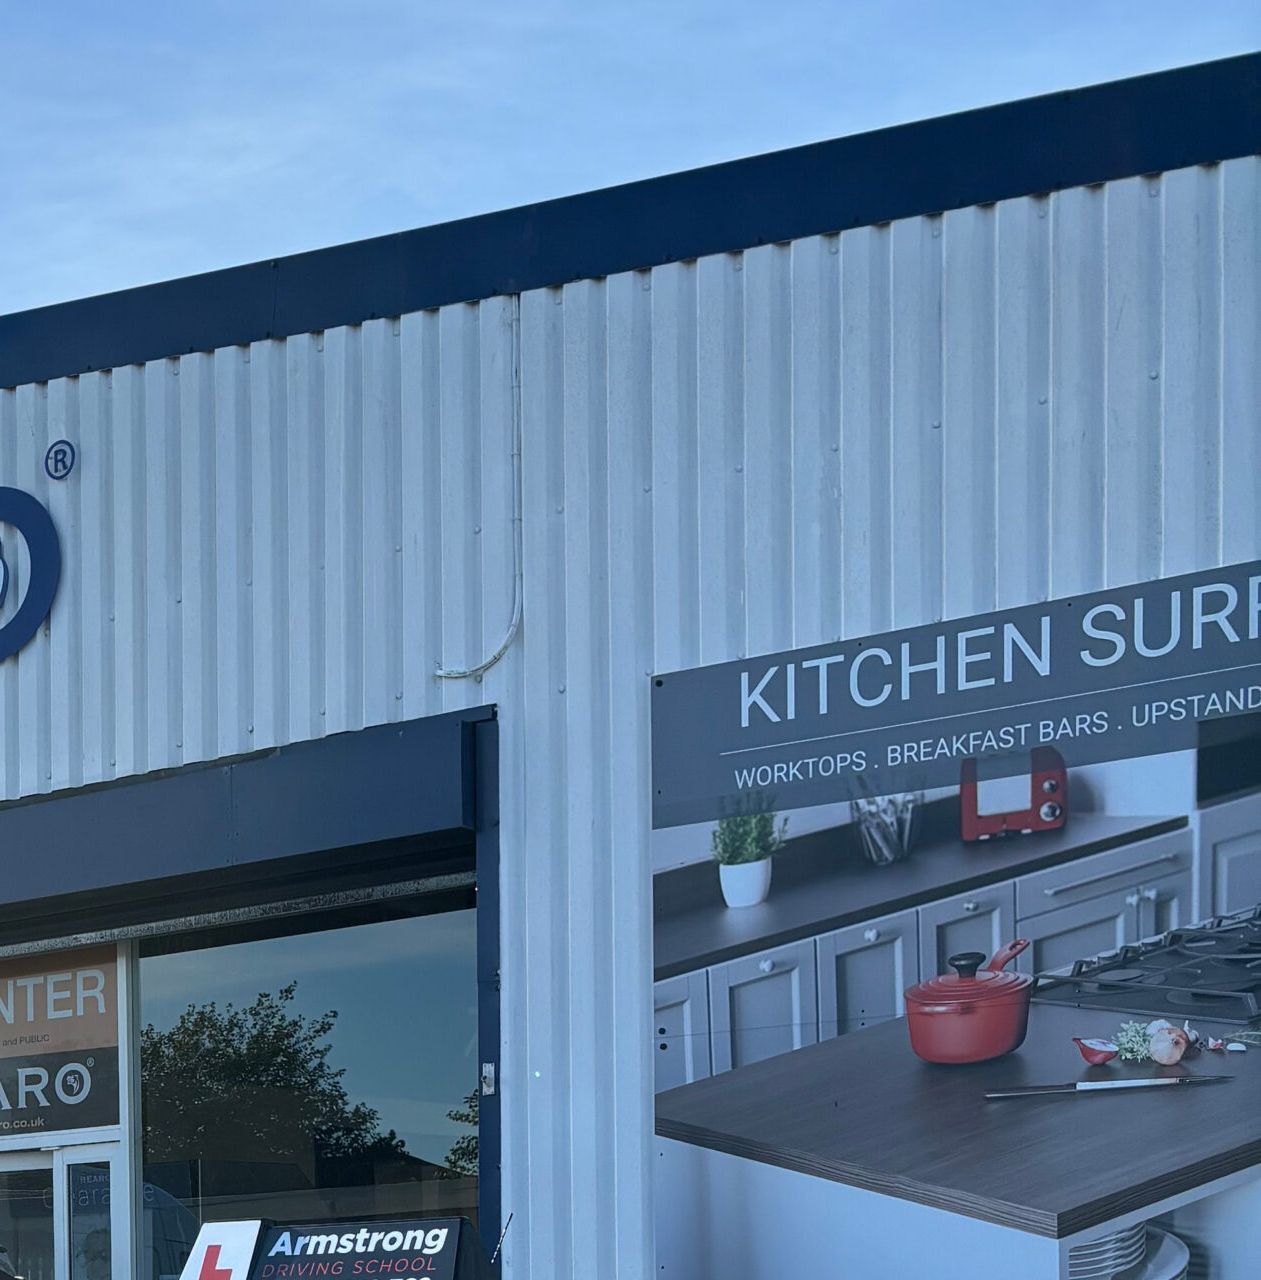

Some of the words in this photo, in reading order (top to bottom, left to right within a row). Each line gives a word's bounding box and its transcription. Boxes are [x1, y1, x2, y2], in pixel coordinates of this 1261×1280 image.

[741, 615, 1051, 727] KITCHEN
[734, 751, 866, 789] WORKTOPS
[887, 723, 1031, 766] BREAKFAST
[1039, 711, 1108, 742] BARS
[2, 1036, 18, 1046] and
[19, 1033, 50, 1045] PUBLIC
[267, 1227, 449, 1257] Armstrong
[261, 1261, 343, 1278] DRIVING
[352, 1256, 437, 1275] SCHOOL
